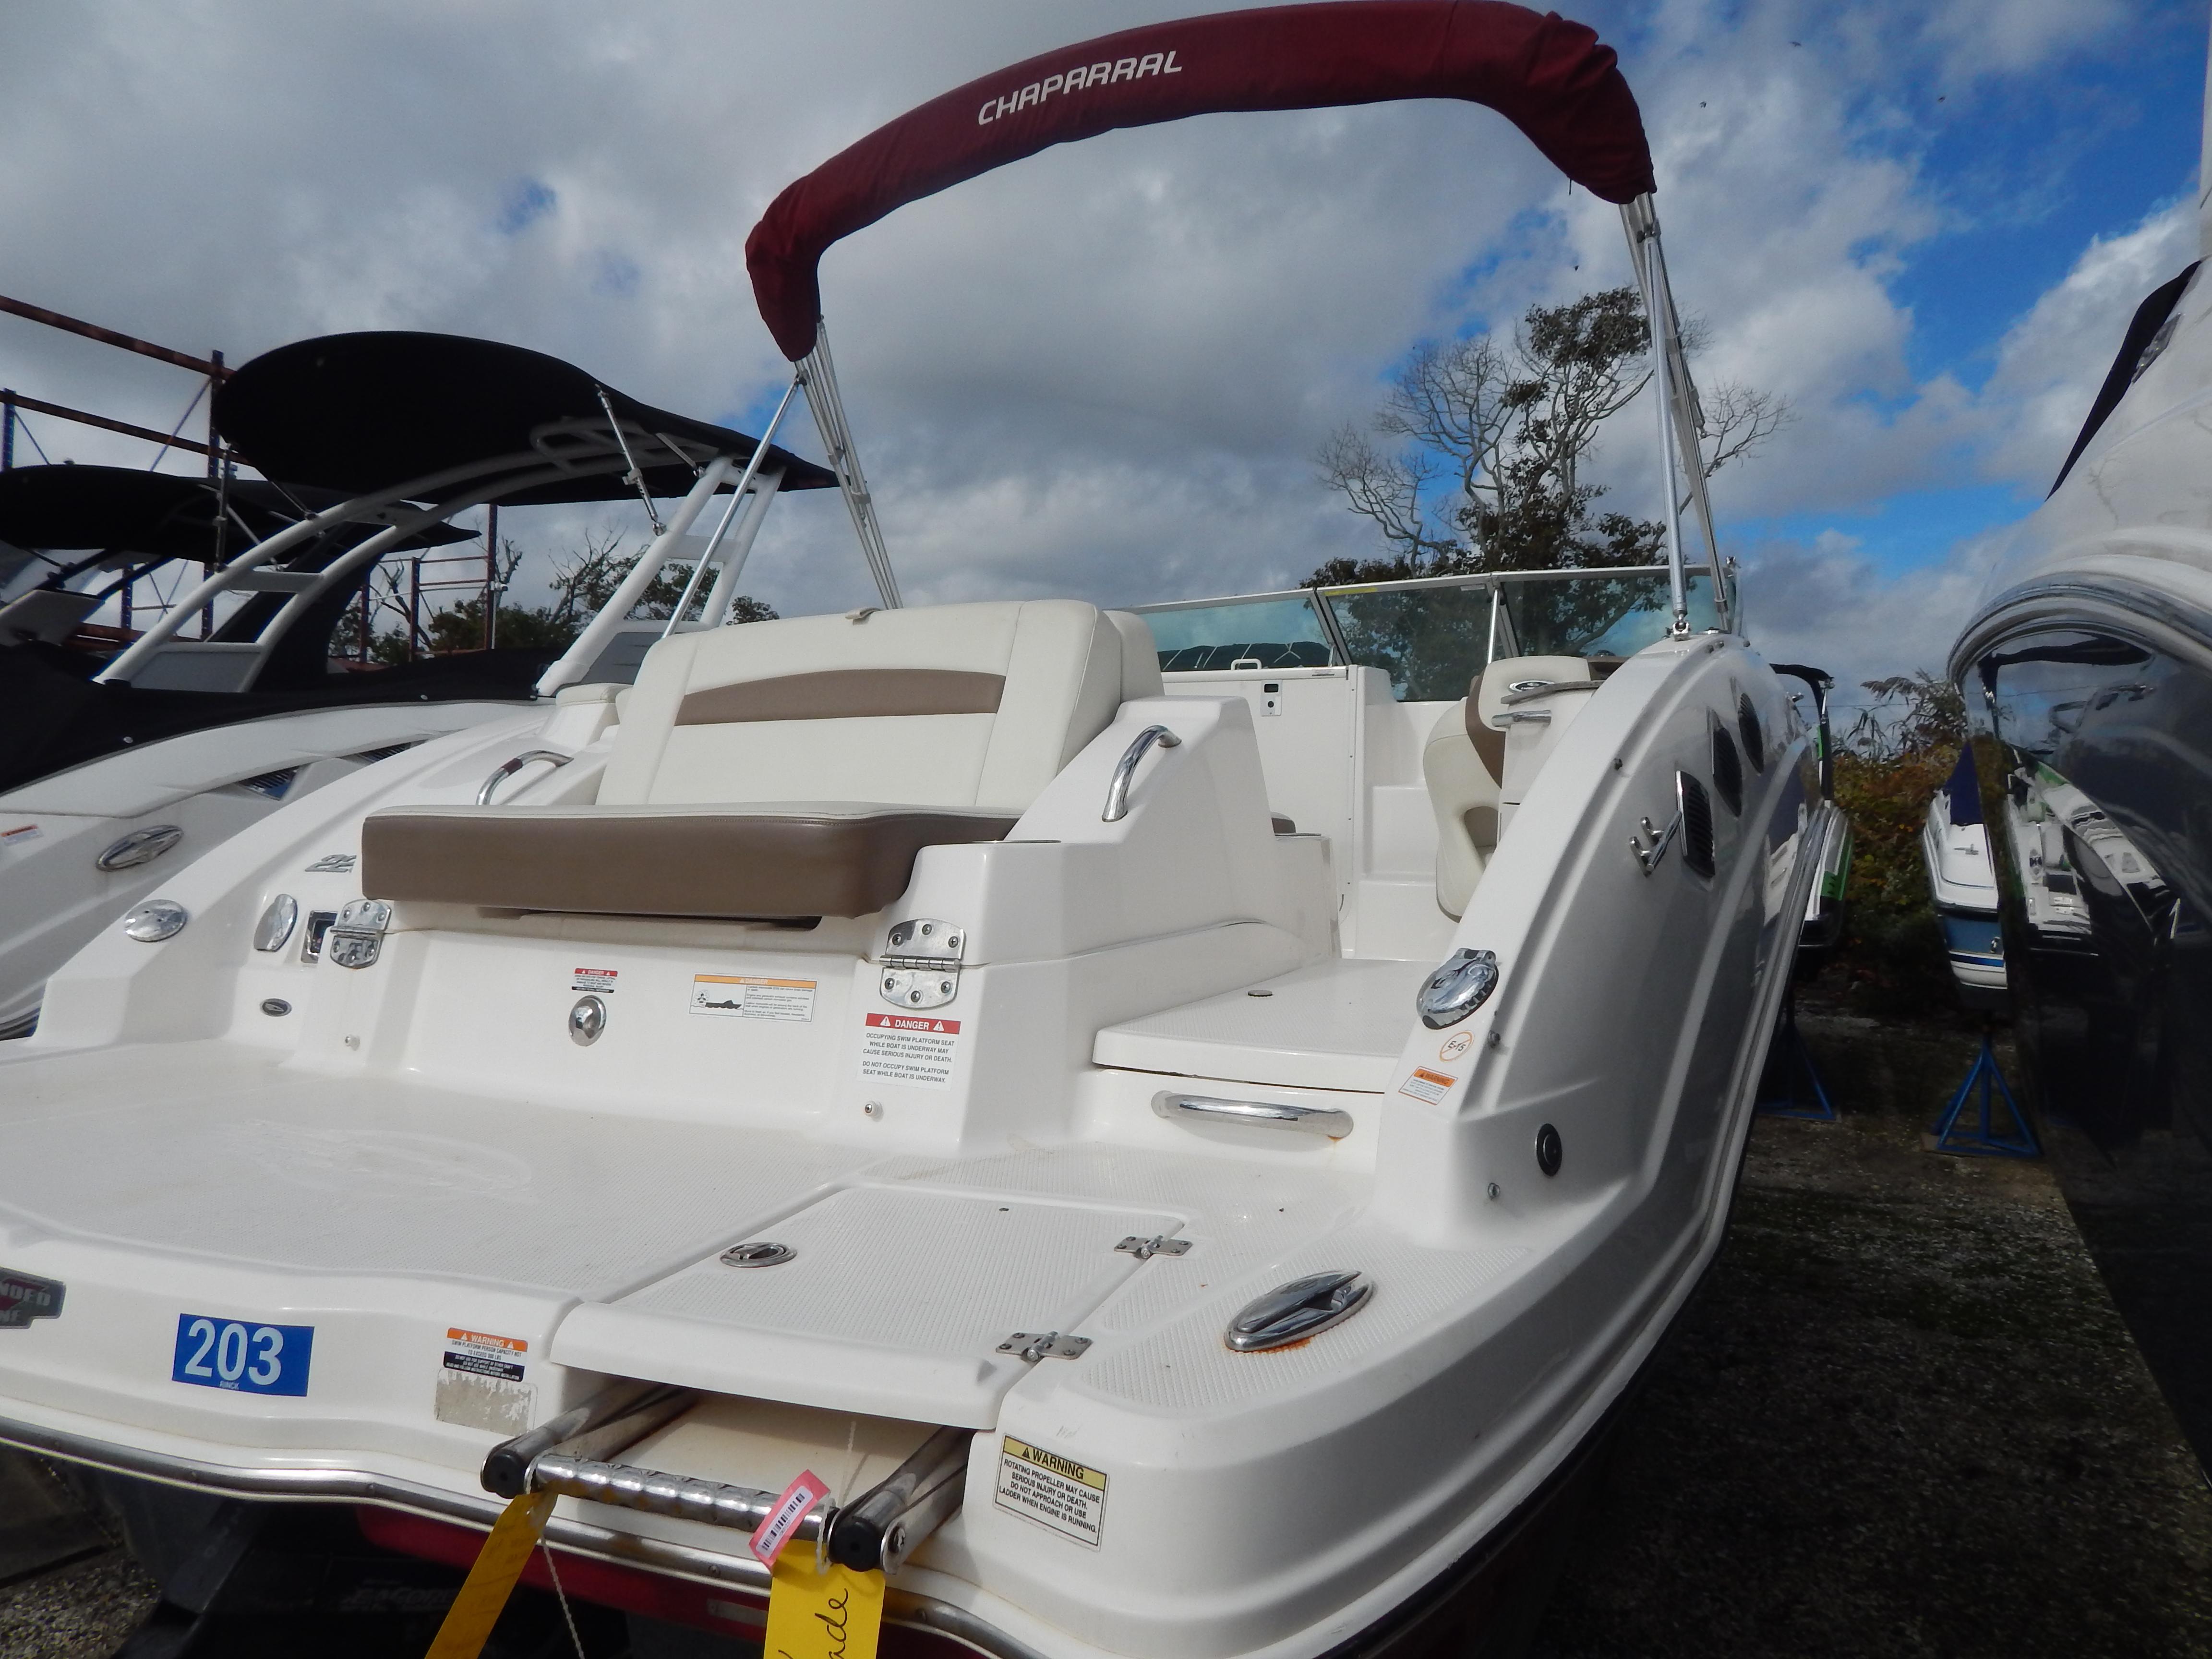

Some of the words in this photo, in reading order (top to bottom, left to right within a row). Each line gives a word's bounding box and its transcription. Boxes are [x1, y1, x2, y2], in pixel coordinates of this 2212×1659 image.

[978, 50, 1182, 126] CHAPARRAL
[895, 1020, 929, 1030] DANGER
[1448, 1041, 1466, 1051] E-15
[185, 1319, 284, 1385] 203
[462, 1342, 481, 1350] PLATFORM
[497, 1347, 513, 1356] CAPACITY
[471, 1334, 505, 1347] WARNING
[1004, 1459, 1031, 1475] ROTATING
[1032, 1470, 1064, 1488] PROPELLER
[1065, 1484, 1078, 1494] MAY
[1079, 1489, 1100, 1503] CAUSE
[1033, 1449, 1084, 1480] WARNING
[999, 1486, 1021, 1501] LADDER
[1022, 1495, 1038, 1508] WHEN
[1039, 1504, 1060, 1517] ENGINE
[1068, 1516, 1097, 1533] RUNNING.
[1010, 1481, 1019, 1489] DO
[1020, 1485, 1032, 1494] NOT
[1032, 1491, 1063, 1508] APPROACH
[1064, 1504, 1073, 1513] OR
[1074, 1508, 1087, 1518] USE
[1012, 1472, 1035, 1486] SERIOUS
[1036, 1482, 1057, 1496] INJURY
[1067, 1495, 1088, 1510] DEATH.
[815, 1587, 849, 1659] ade
